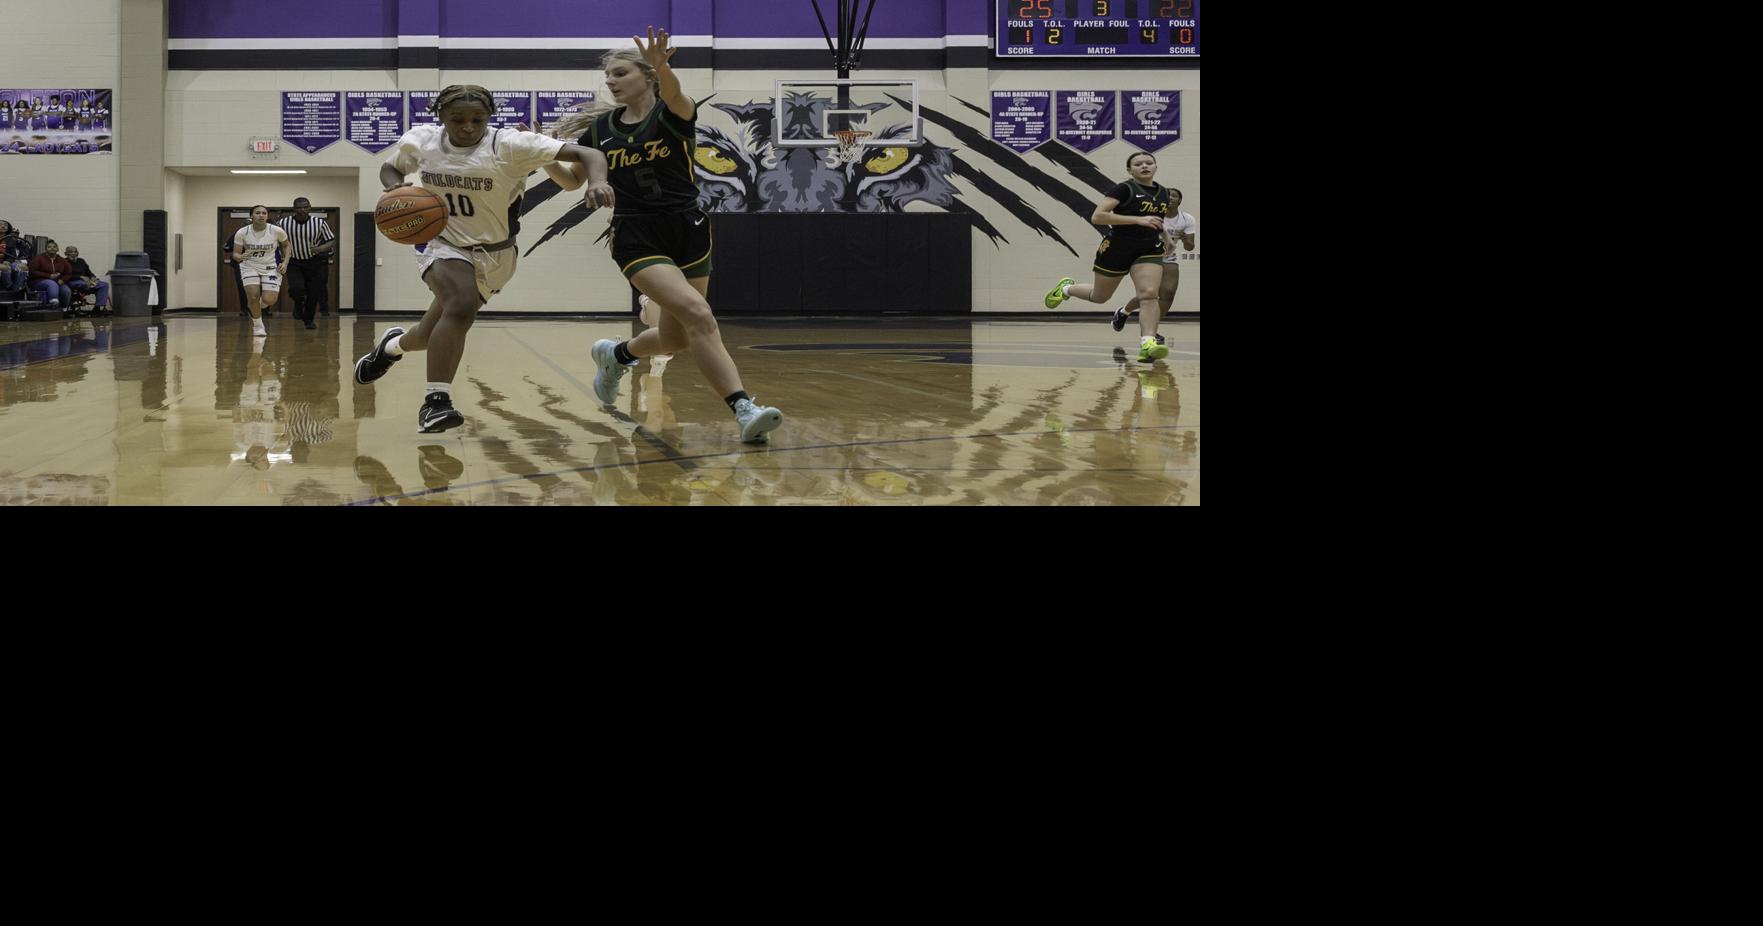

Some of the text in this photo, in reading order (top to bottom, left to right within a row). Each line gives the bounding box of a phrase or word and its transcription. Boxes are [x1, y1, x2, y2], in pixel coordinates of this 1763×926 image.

[1020, 0, 1052, 17] 25
[1097, 0, 1108, 16] 3
[1160, 0, 1192, 17] 22
[1043, 20, 1066, 28] T.O.L.
[1026, 29, 1030, 43] 1
[1048, 28, 1060, 44] 2
[1143, 29, 1155, 43] 4
[1180, 28, 1192, 44] 0
[256, 141, 272, 151] EXIT
[607, 139, 671, 170] The Fe
[421, 171, 494, 191] WILDCATS
[634, 167, 663, 200] 5
[445, 193, 475, 217] 10
[1139, 201, 1158, 212] The
